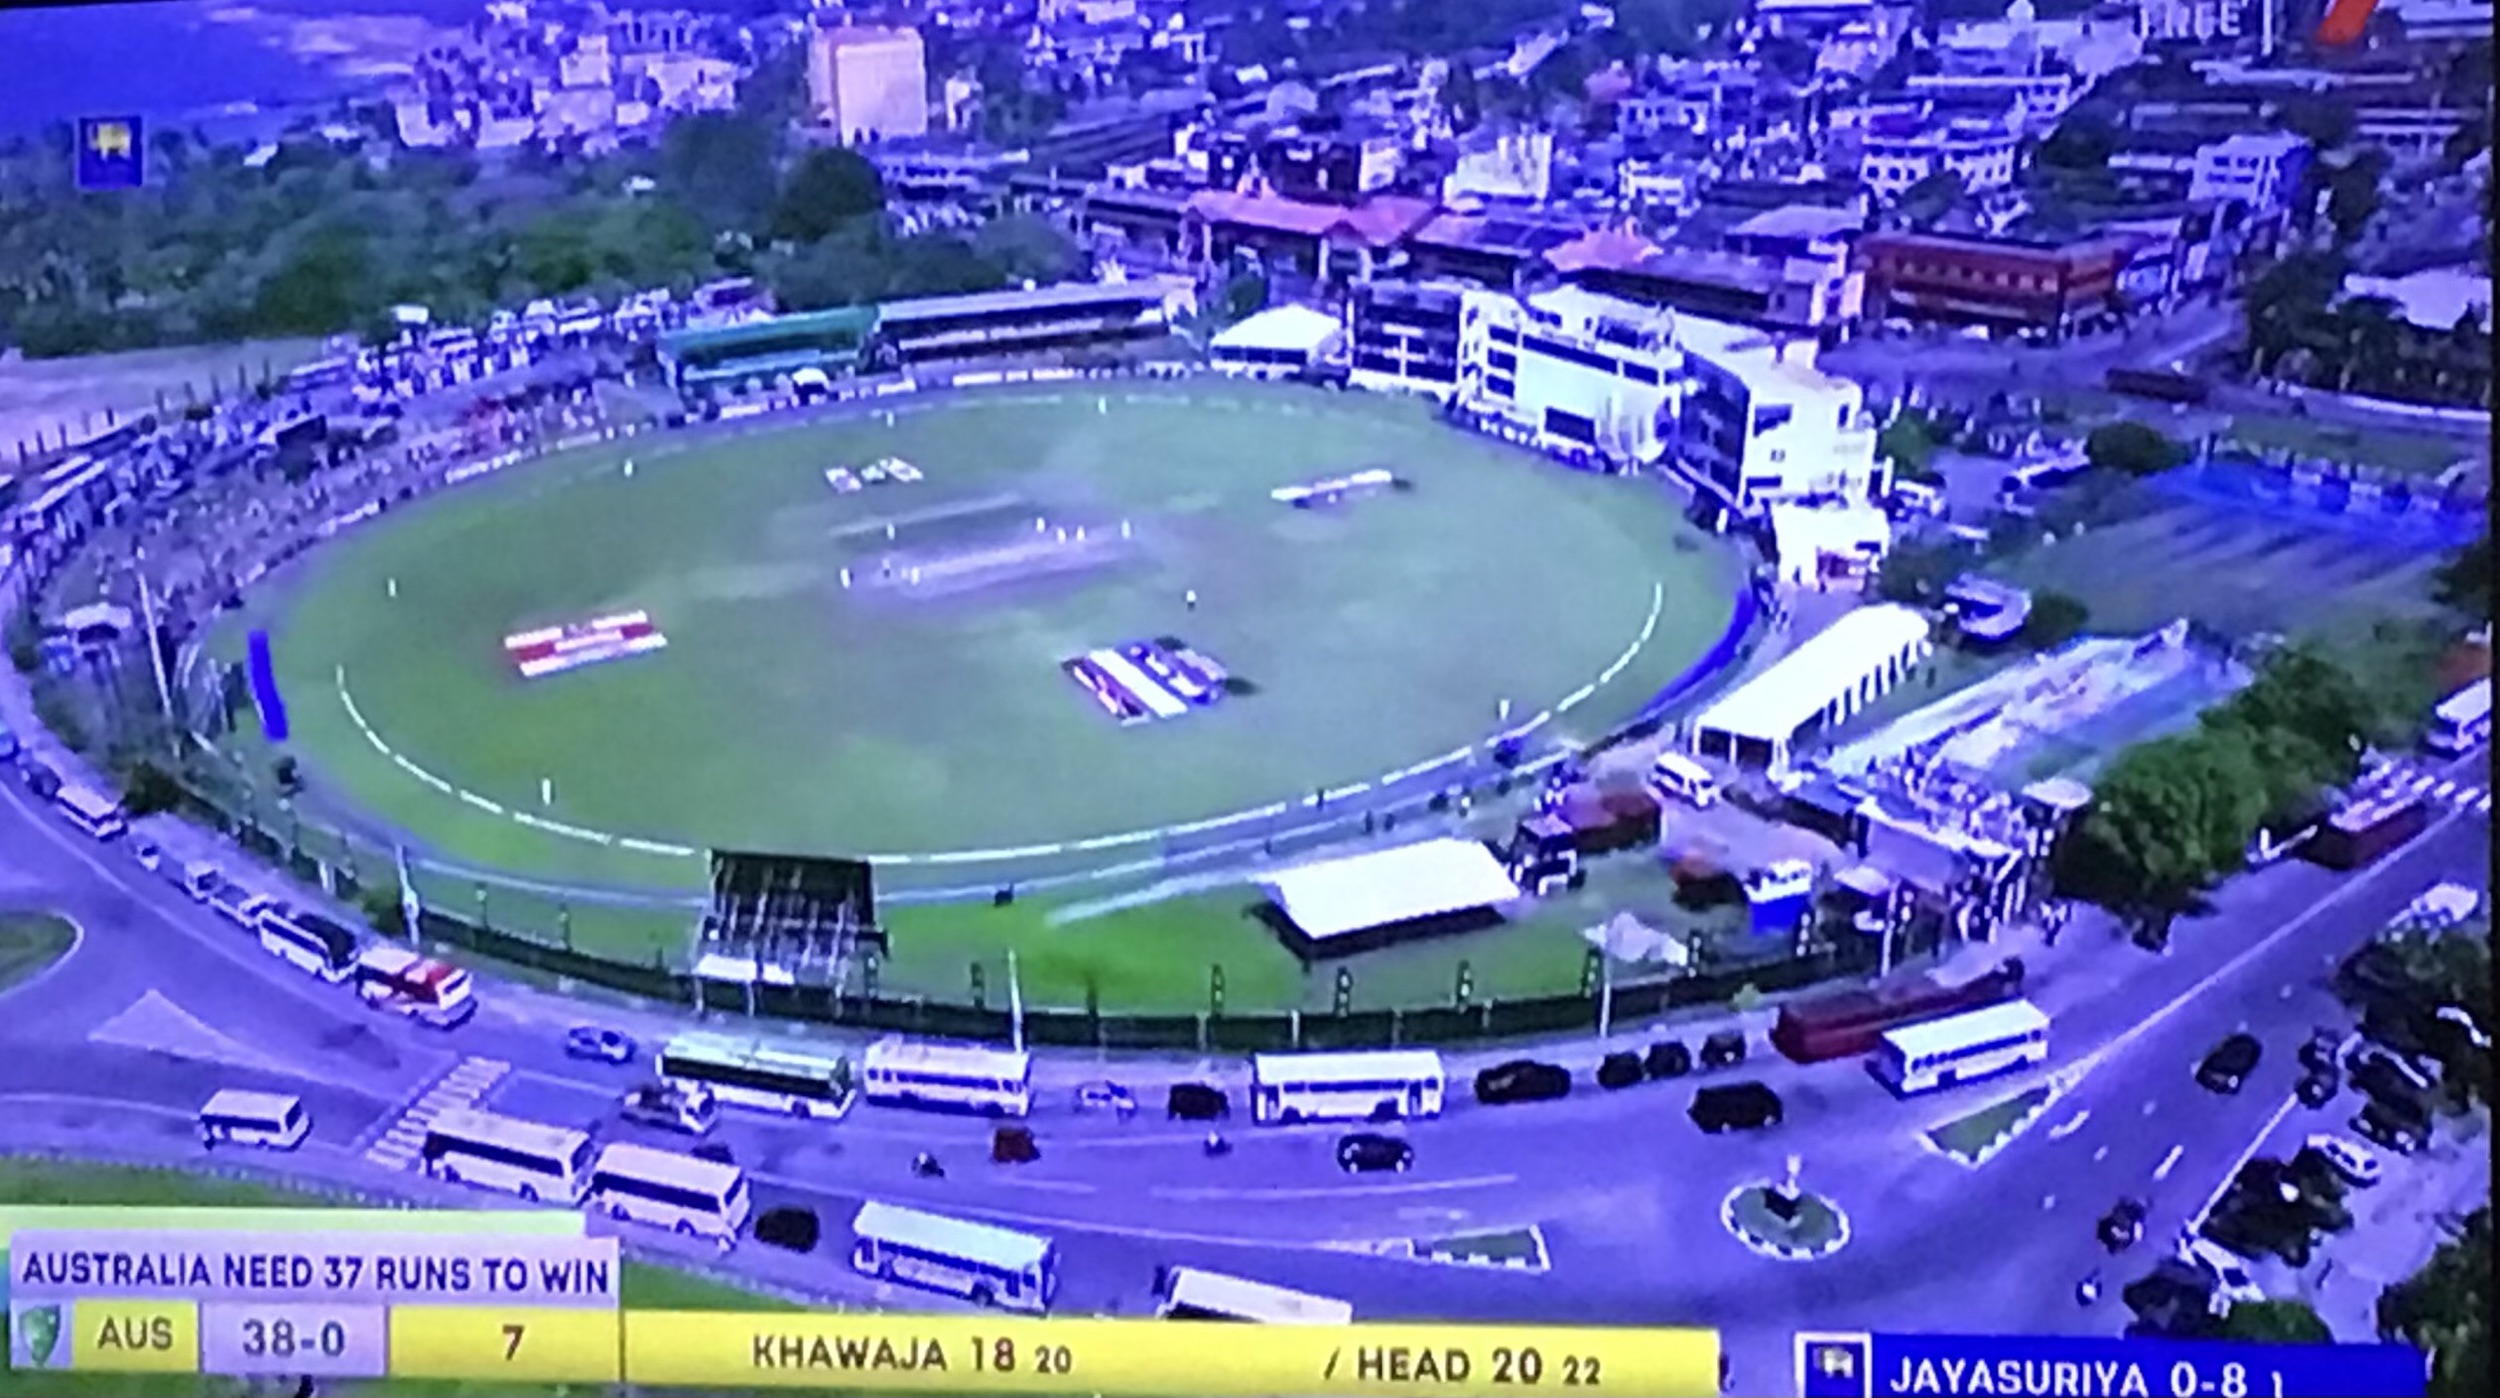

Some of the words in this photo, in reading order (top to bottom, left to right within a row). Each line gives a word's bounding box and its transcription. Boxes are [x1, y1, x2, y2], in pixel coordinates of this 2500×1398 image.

[22, 1251, 212, 1287] AUSTRALIA
[224, 1253, 313, 1289] NEED
[324, 1256, 363, 1290] 37
[376, 1257, 471, 1292] RUNS
[482, 1258, 528, 1292] TO
[539, 1259, 608, 1294] WIN
[97, 1316, 173, 1352] AUS
[242, 1318, 345, 1359] 38-0
[502, 1324, 525, 1361] 7
[753, 1334, 947, 1372] KHAWAJA
[971, 1336, 1016, 1373] 18
[1035, 1345, 1072, 1375] 20
[1358, 1346, 1471, 1383] HEAD
[1492, 1347, 1543, 1385] 20
[1562, 1355, 1601, 1387] 22
[1889, 1356, 2149, 1398] JAYASURIYA
[2170, 1361, 2248, 1398] 0-8
